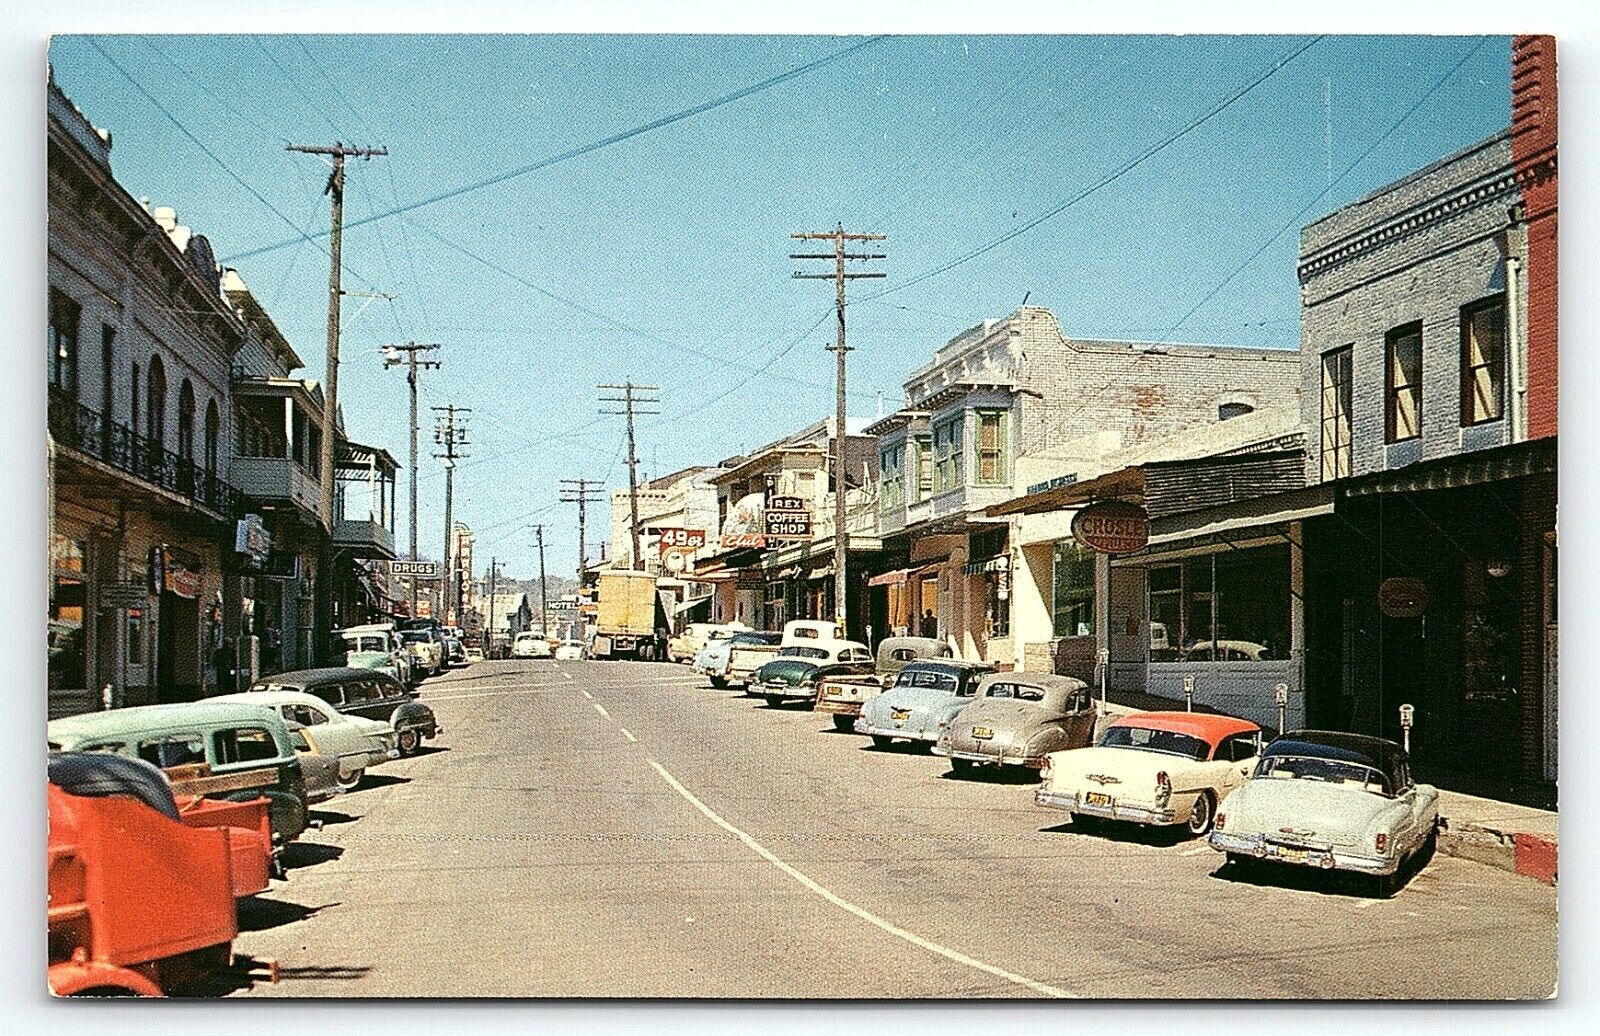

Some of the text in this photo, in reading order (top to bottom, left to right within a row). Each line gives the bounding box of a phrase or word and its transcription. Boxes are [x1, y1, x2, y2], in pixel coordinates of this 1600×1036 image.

[775, 500, 800, 508] REX
[767, 513, 809, 523] COFFEE
[771, 523, 806, 533] SHOP
[1081, 517, 1142, 537] CROSLE
[394, 563, 433, 574] DRUGS
